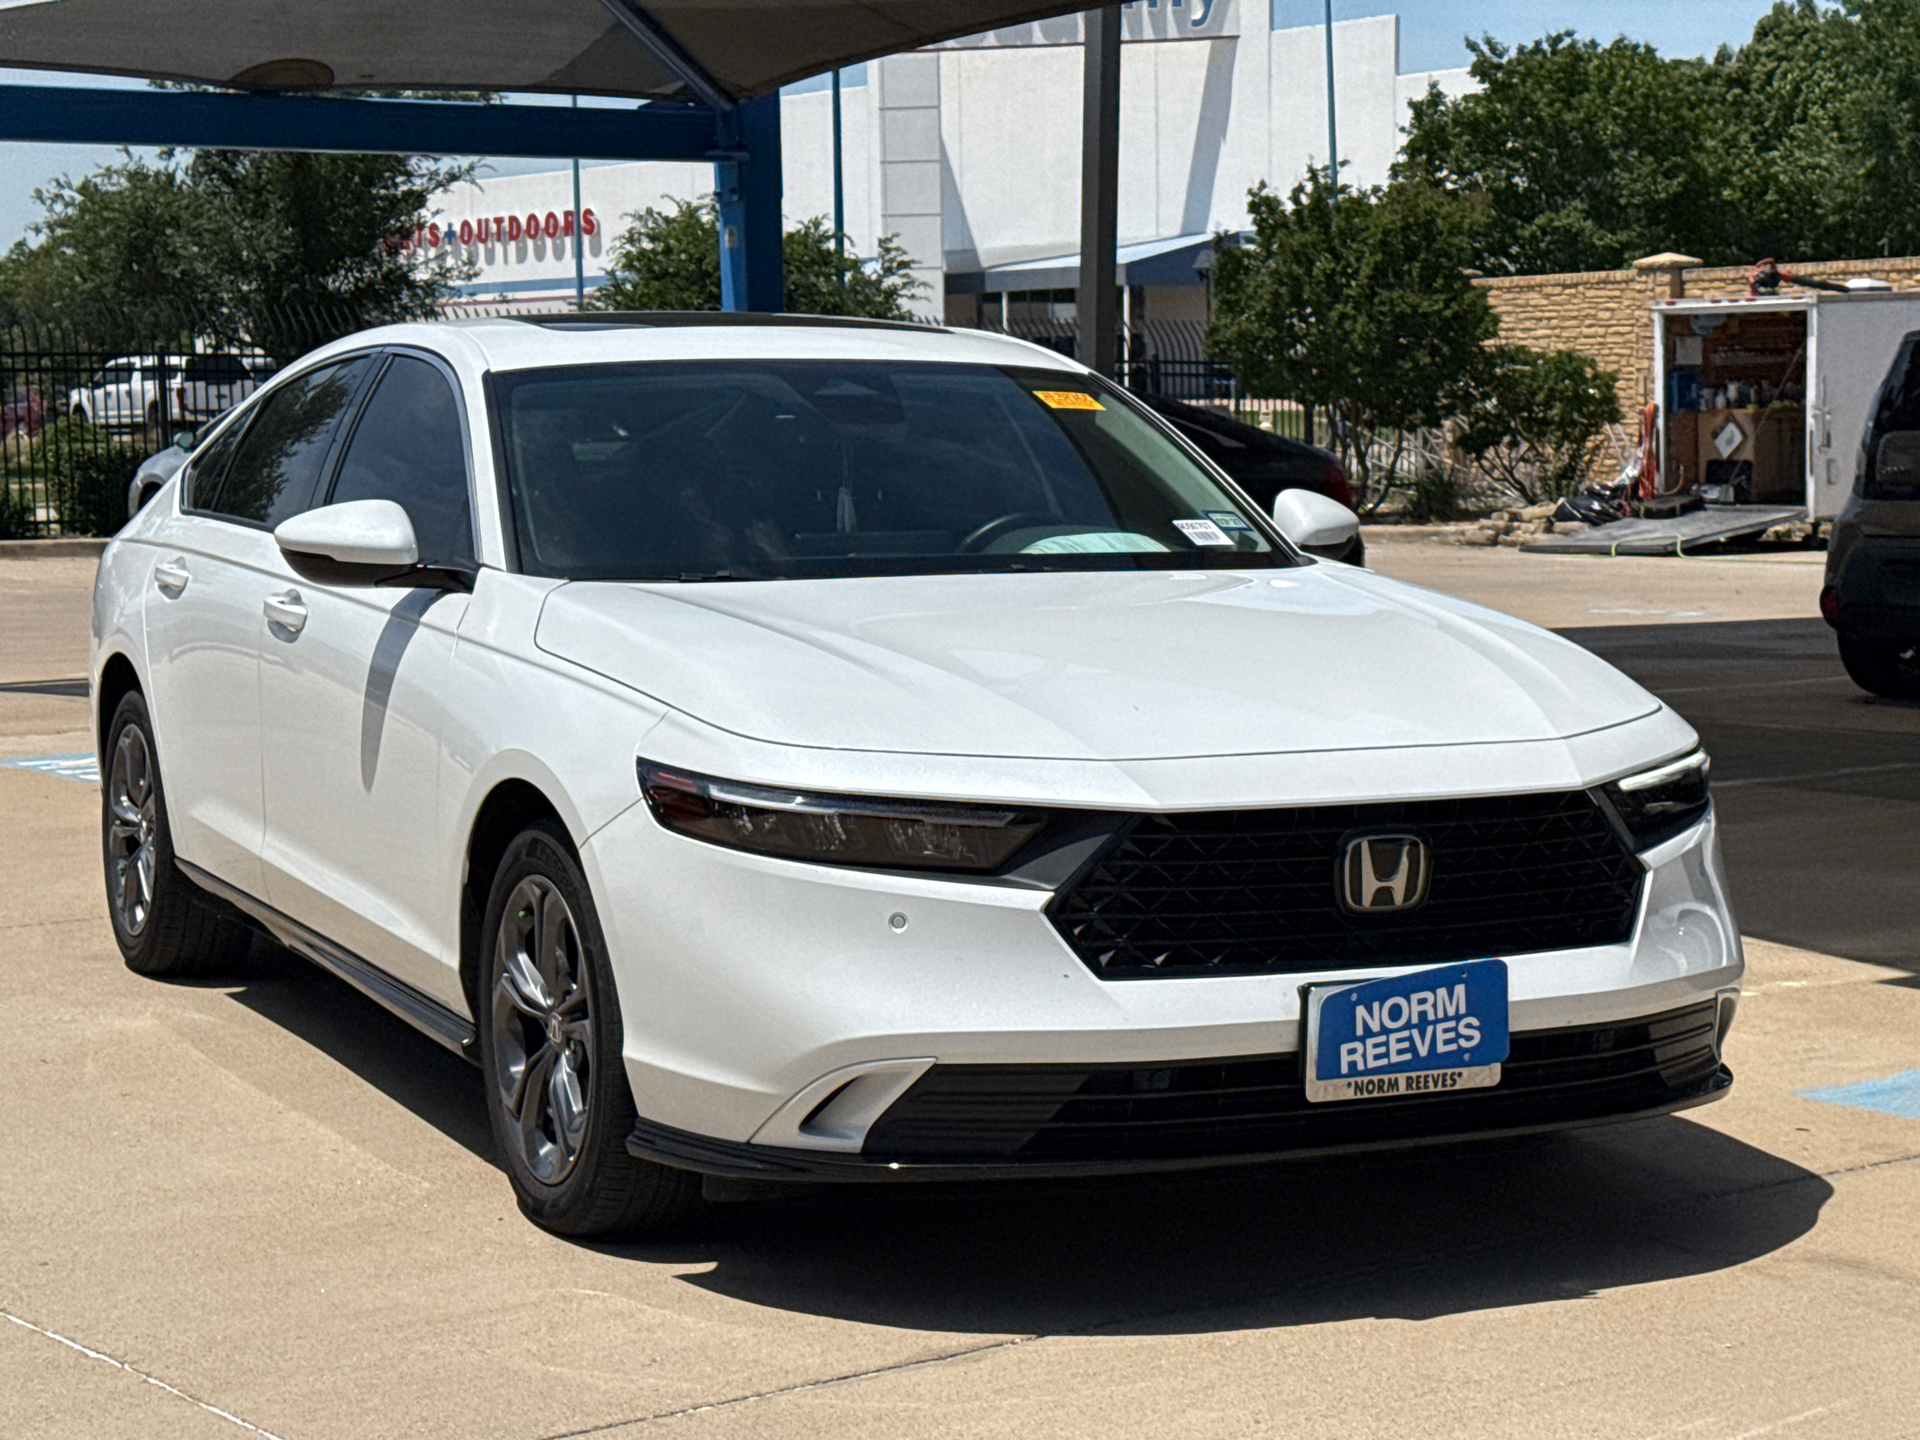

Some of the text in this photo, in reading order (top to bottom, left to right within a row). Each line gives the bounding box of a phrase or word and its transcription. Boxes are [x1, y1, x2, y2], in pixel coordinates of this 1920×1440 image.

[460, 208, 596, 246] OUTDOORS
[1355, 983, 1467, 1037] NORM
[1340, 1016, 1482, 1075] REEVES
